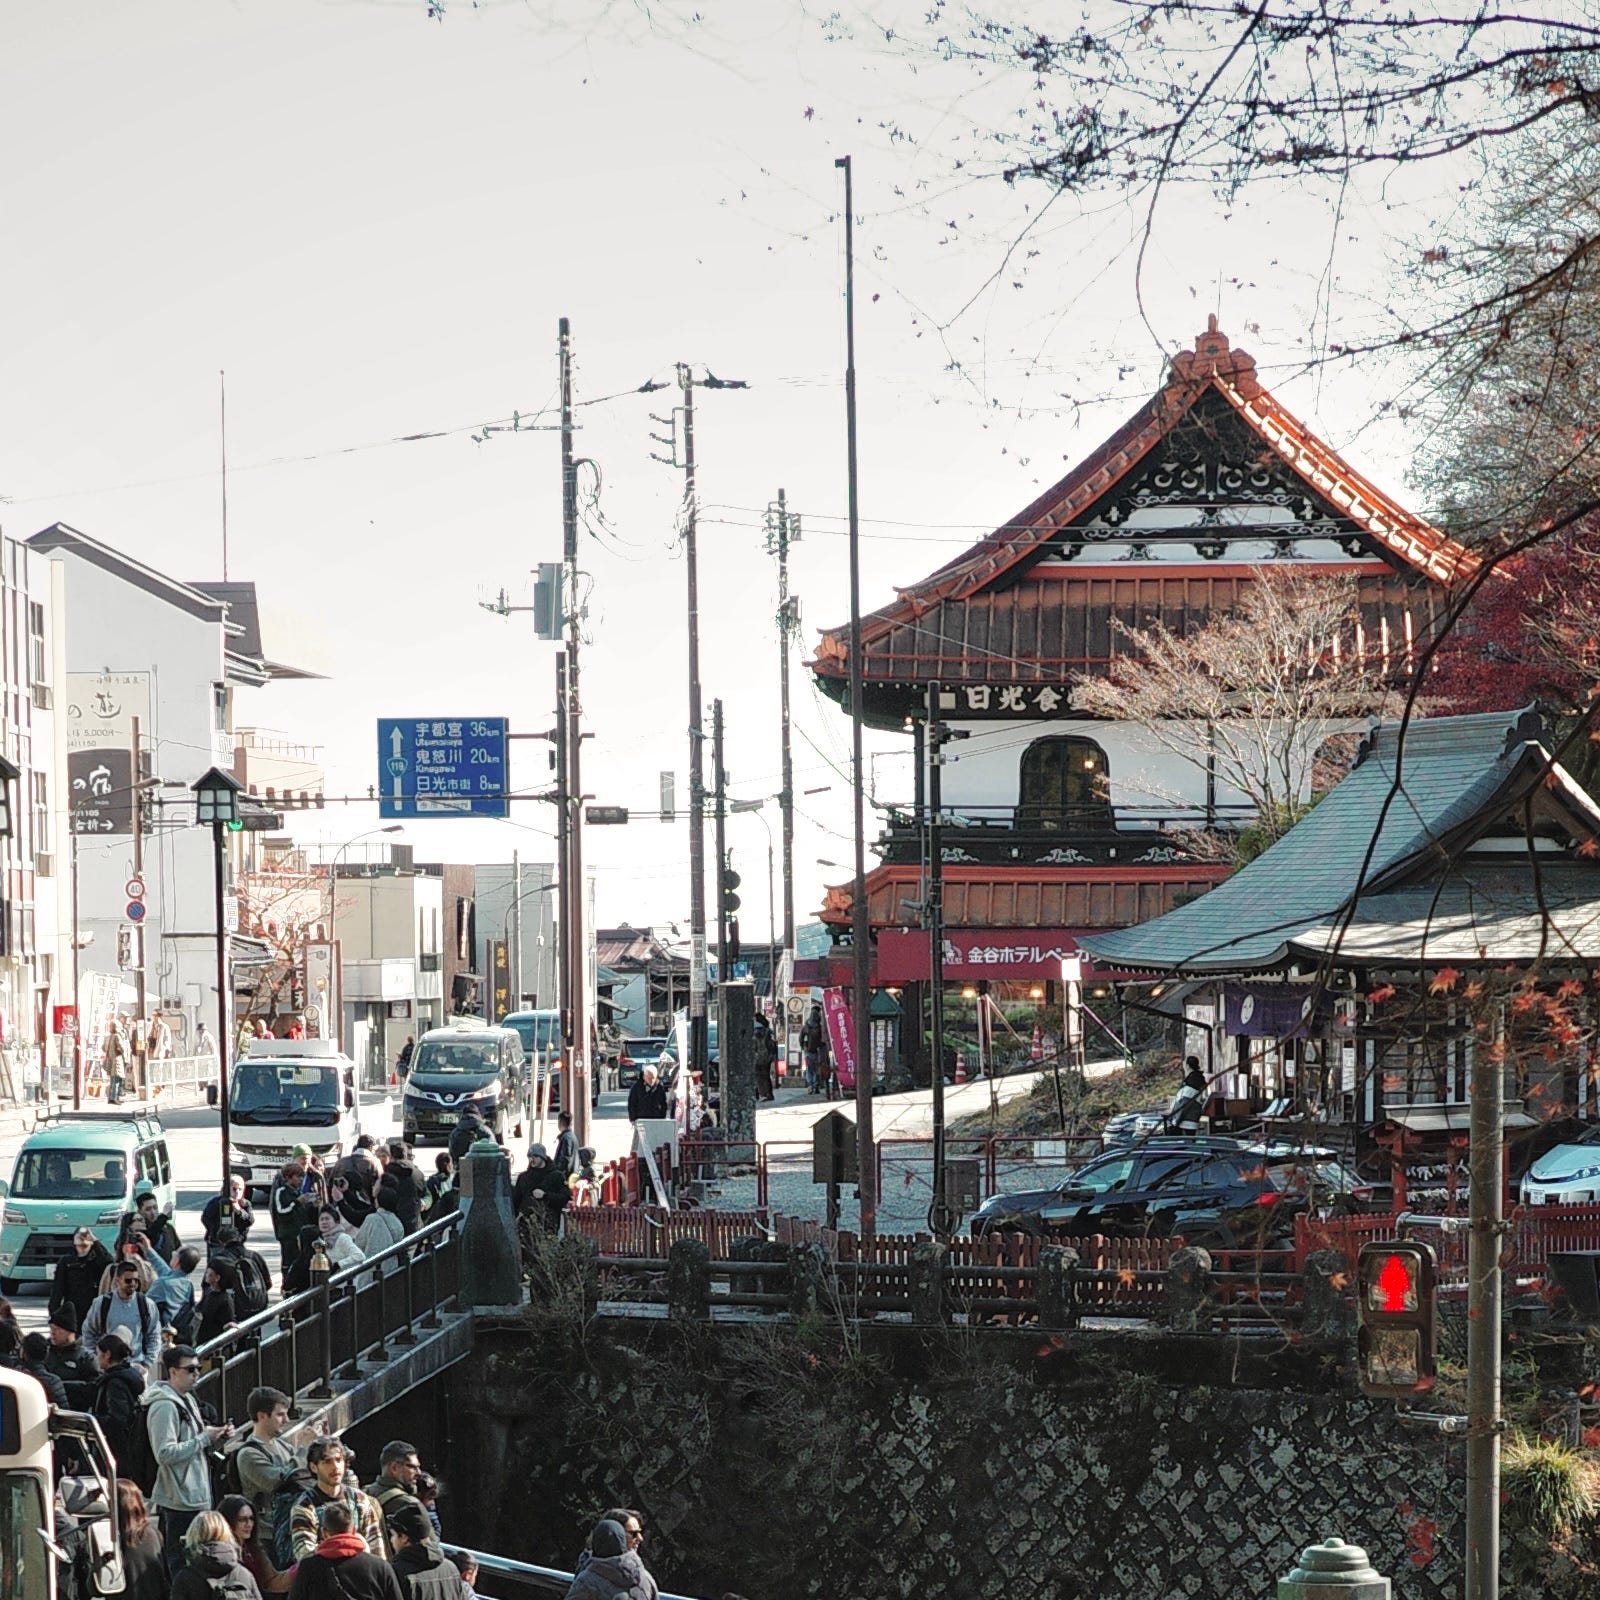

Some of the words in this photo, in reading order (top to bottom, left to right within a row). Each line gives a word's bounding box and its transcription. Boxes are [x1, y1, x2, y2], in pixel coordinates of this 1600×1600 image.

[415, 722, 463, 738] 宇都宮
[470, 721, 500, 737] 36km
[416, 749, 462, 765] 鬼怒川
[470, 748, 500, 764] 20km
[479, 774, 501, 791] 8km
[130, 884, 142, 894] 40
[968, 946, 1101, 964] 金谷ホテルベーカ
